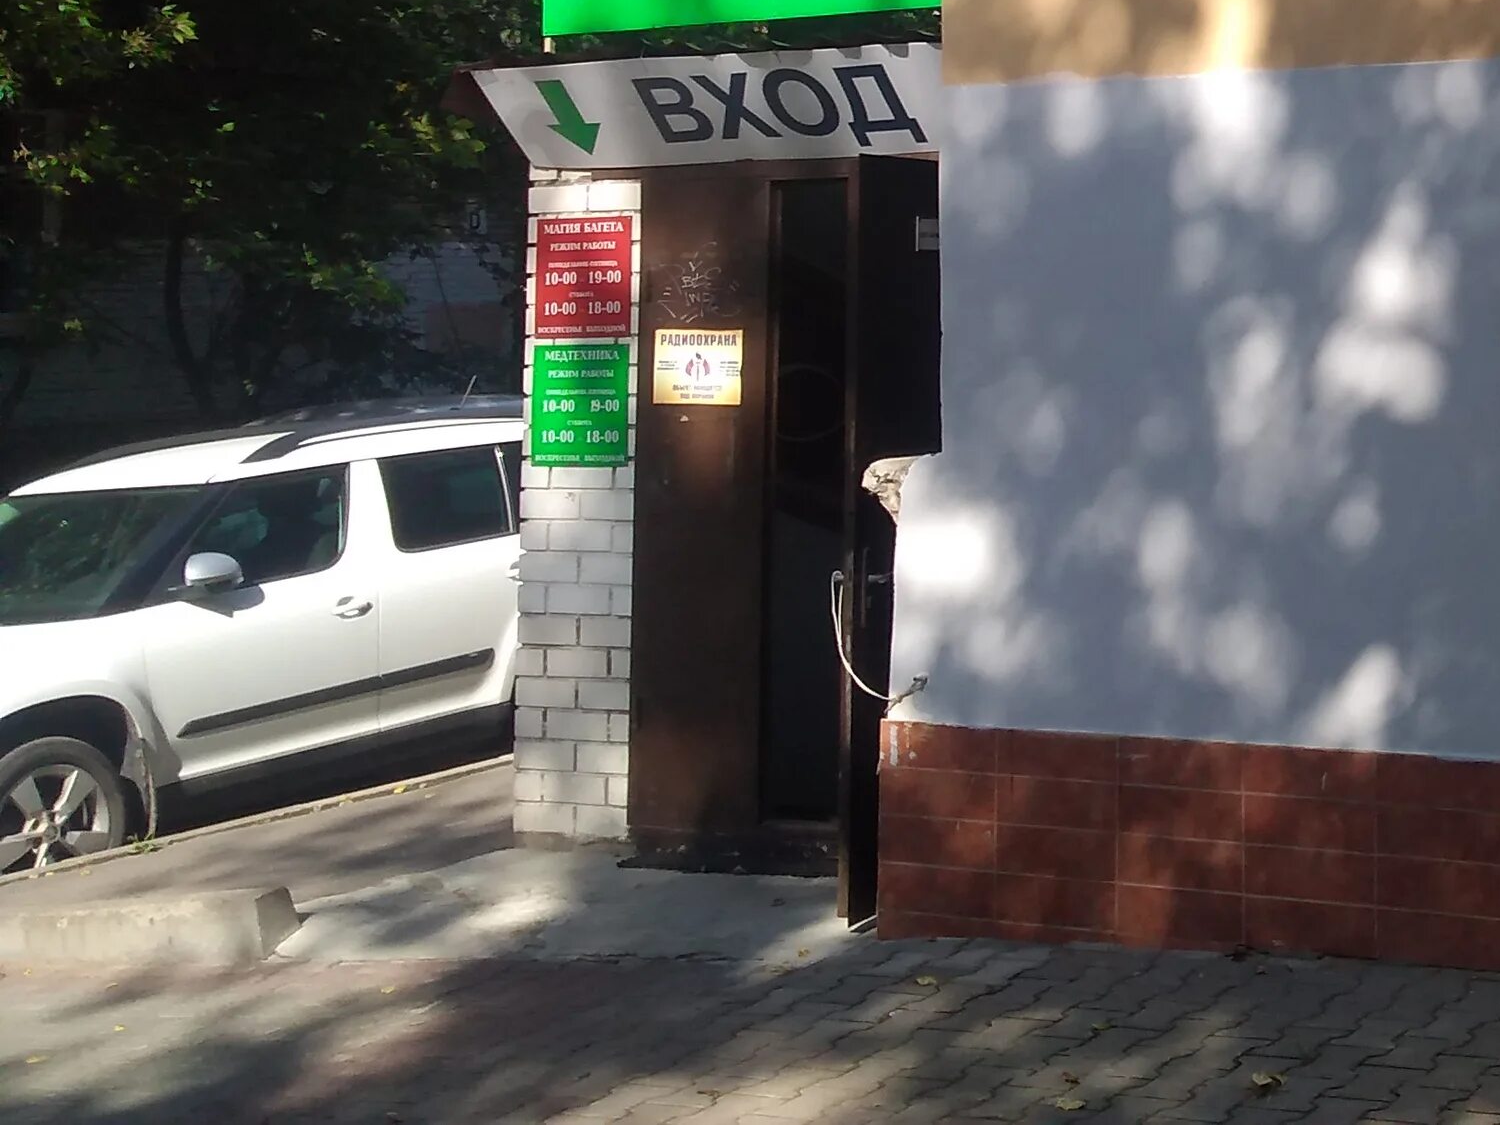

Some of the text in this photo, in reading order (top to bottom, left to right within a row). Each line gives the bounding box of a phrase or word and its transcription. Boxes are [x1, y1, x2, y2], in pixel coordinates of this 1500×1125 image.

[632, 63, 928, 148] ВХОД
[544, 221, 625, 235] МАГИЯ БАГЕТА
[550, 240, 617, 252] РЕЖИМ РАБОТЫ
[545, 269, 622, 286] 10-00 19-00
[544, 301, 621, 316] 10-00 18-00
[660, 333, 738, 347] РАДИООХРАНА
[544, 349, 620, 363] МЕДТЕХНИКА
[542, 398, 620, 413] 10-00 19-00
[541, 429, 620, 443] 10-00 18-00
